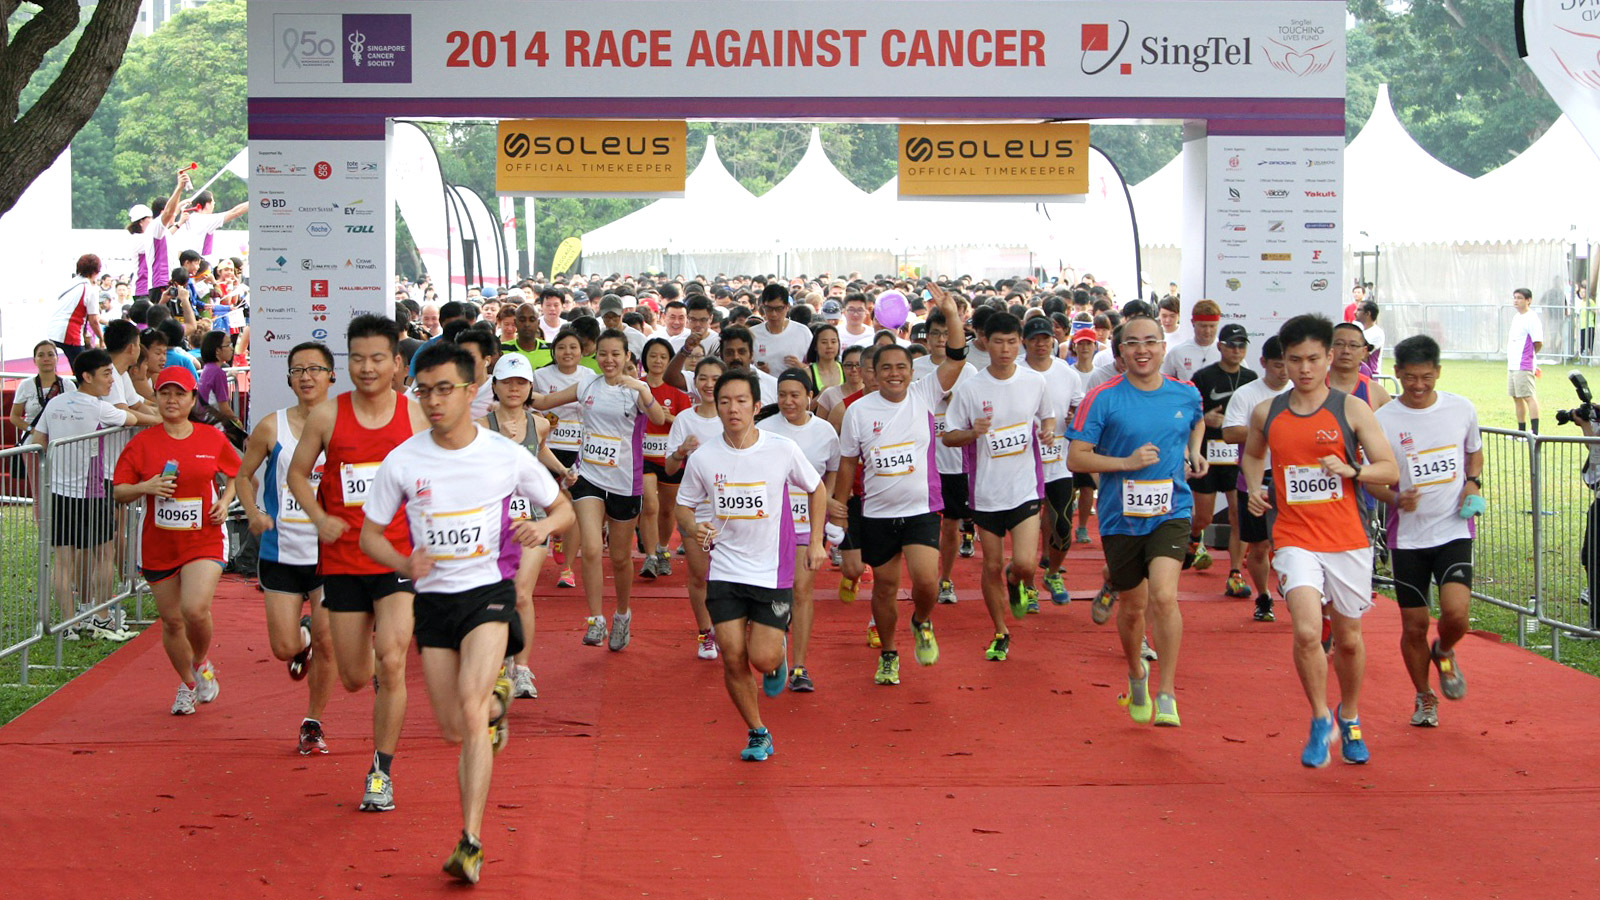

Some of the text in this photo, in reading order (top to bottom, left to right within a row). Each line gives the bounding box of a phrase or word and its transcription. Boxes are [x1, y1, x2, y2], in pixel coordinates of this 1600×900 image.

[1278, 26, 1324, 34] TOUCHING
[446, 29, 1046, 68] 2014 RACE AGAINST CANCER
[1140, 36, 1252, 72] SingTel
[505, 164, 672, 172] OFFICIAL TIMEKEEPER
[908, 166, 1075, 176] OFFICIAL TIMEKEEPER
[272, 199, 286, 207] BD
[553, 429, 582, 438] 40921
[642, 441, 668, 451] 40918
[991, 434, 1028, 451] 31212
[584, 443, 616, 458] 40442
[1209, 448, 1238, 458] 31613
[875, 453, 913, 469] 31544
[1413, 458, 1456, 477] 31435
[1290, 477, 1337, 493] 30606
[718, 496, 763, 508] 30936
[1127, 493, 1168, 506] 31430
[157, 508, 198, 521] 40965
[792, 504, 806, 514] 45
[426, 526, 481, 546] 31067
